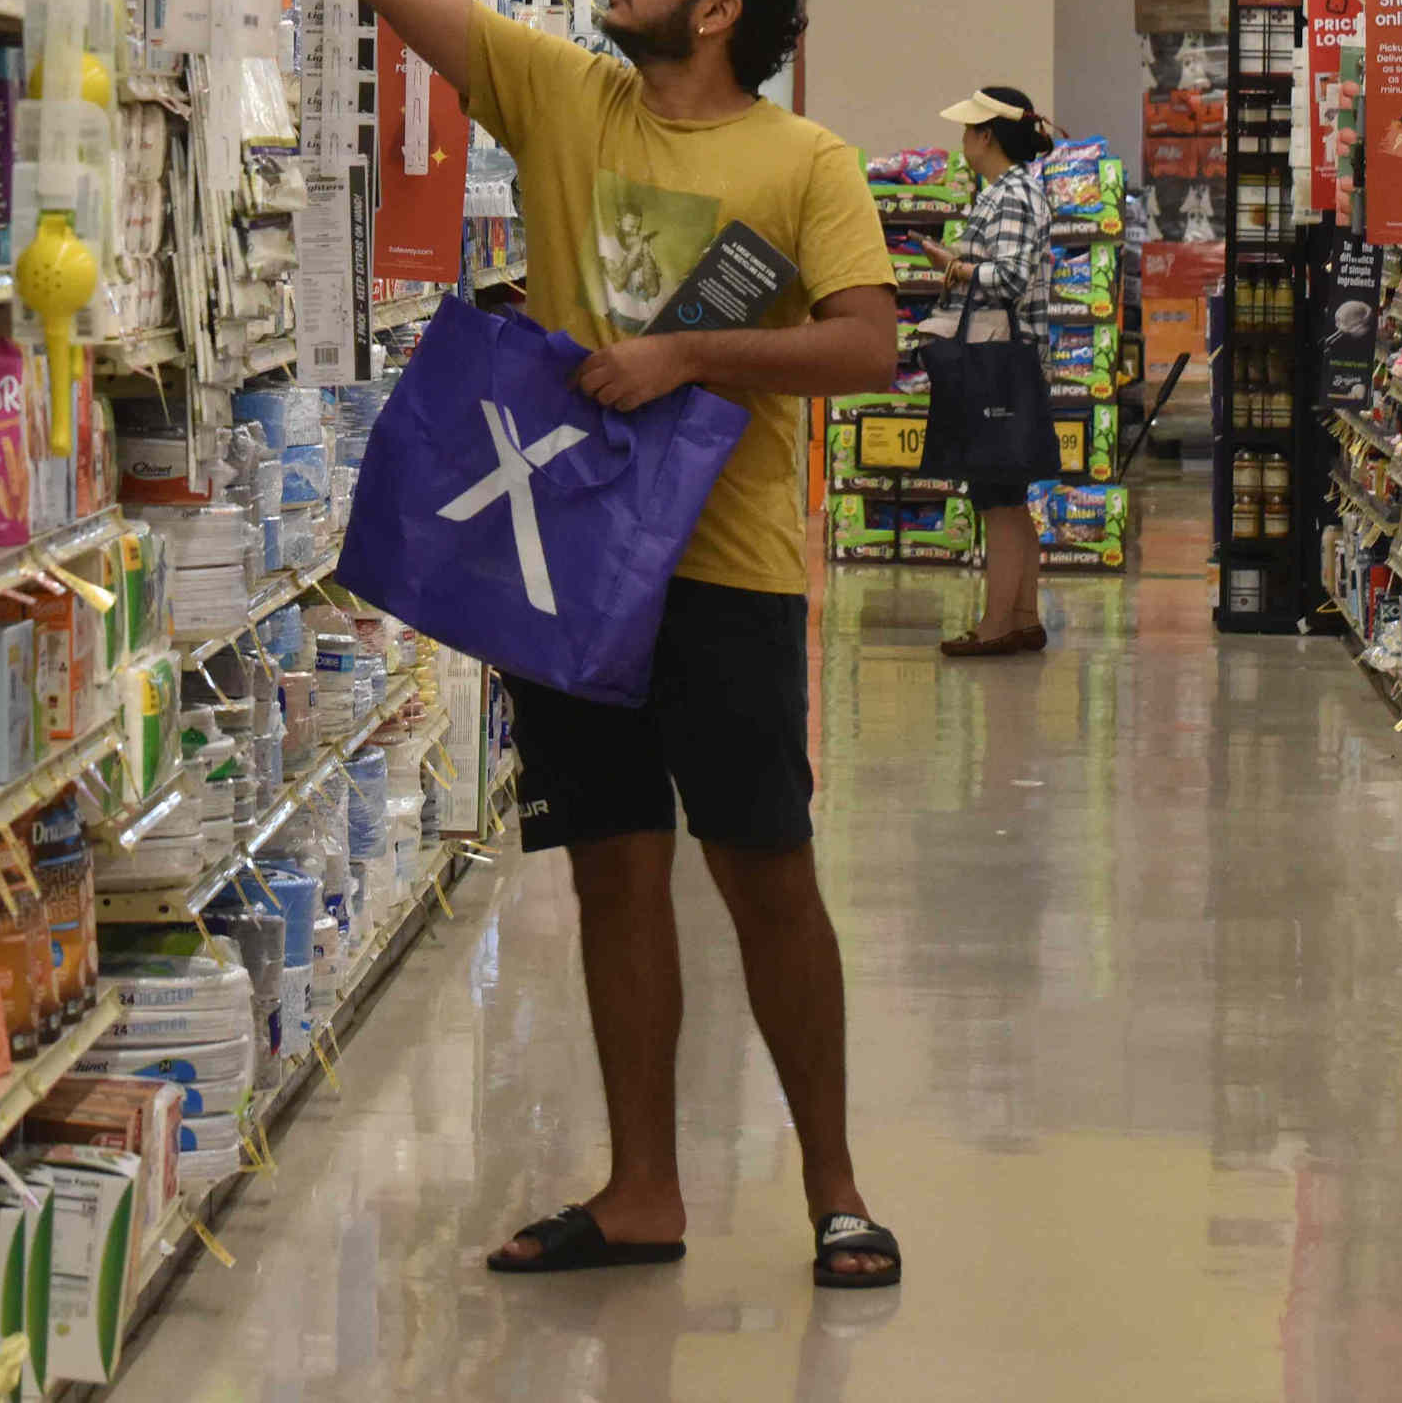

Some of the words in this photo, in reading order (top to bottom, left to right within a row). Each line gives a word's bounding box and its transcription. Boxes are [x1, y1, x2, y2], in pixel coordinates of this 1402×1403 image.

[352, 194, 363, 223] HAND!
[354, 223, 364, 238] ON
[354, 240, 365, 274] EXTRAS
[1341, 262, 1348, 273] of
[1348, 264, 1372, 276] simple
[355, 275, 367, 301] KEEP
[1337, 276, 1376, 288] ingredients
[119, 993, 135, 1005] 24
[112, 1024, 128, 1036] 24
[74, 1060, 109, 1072] hinet
[830, 1216, 869, 1232] NIKE
